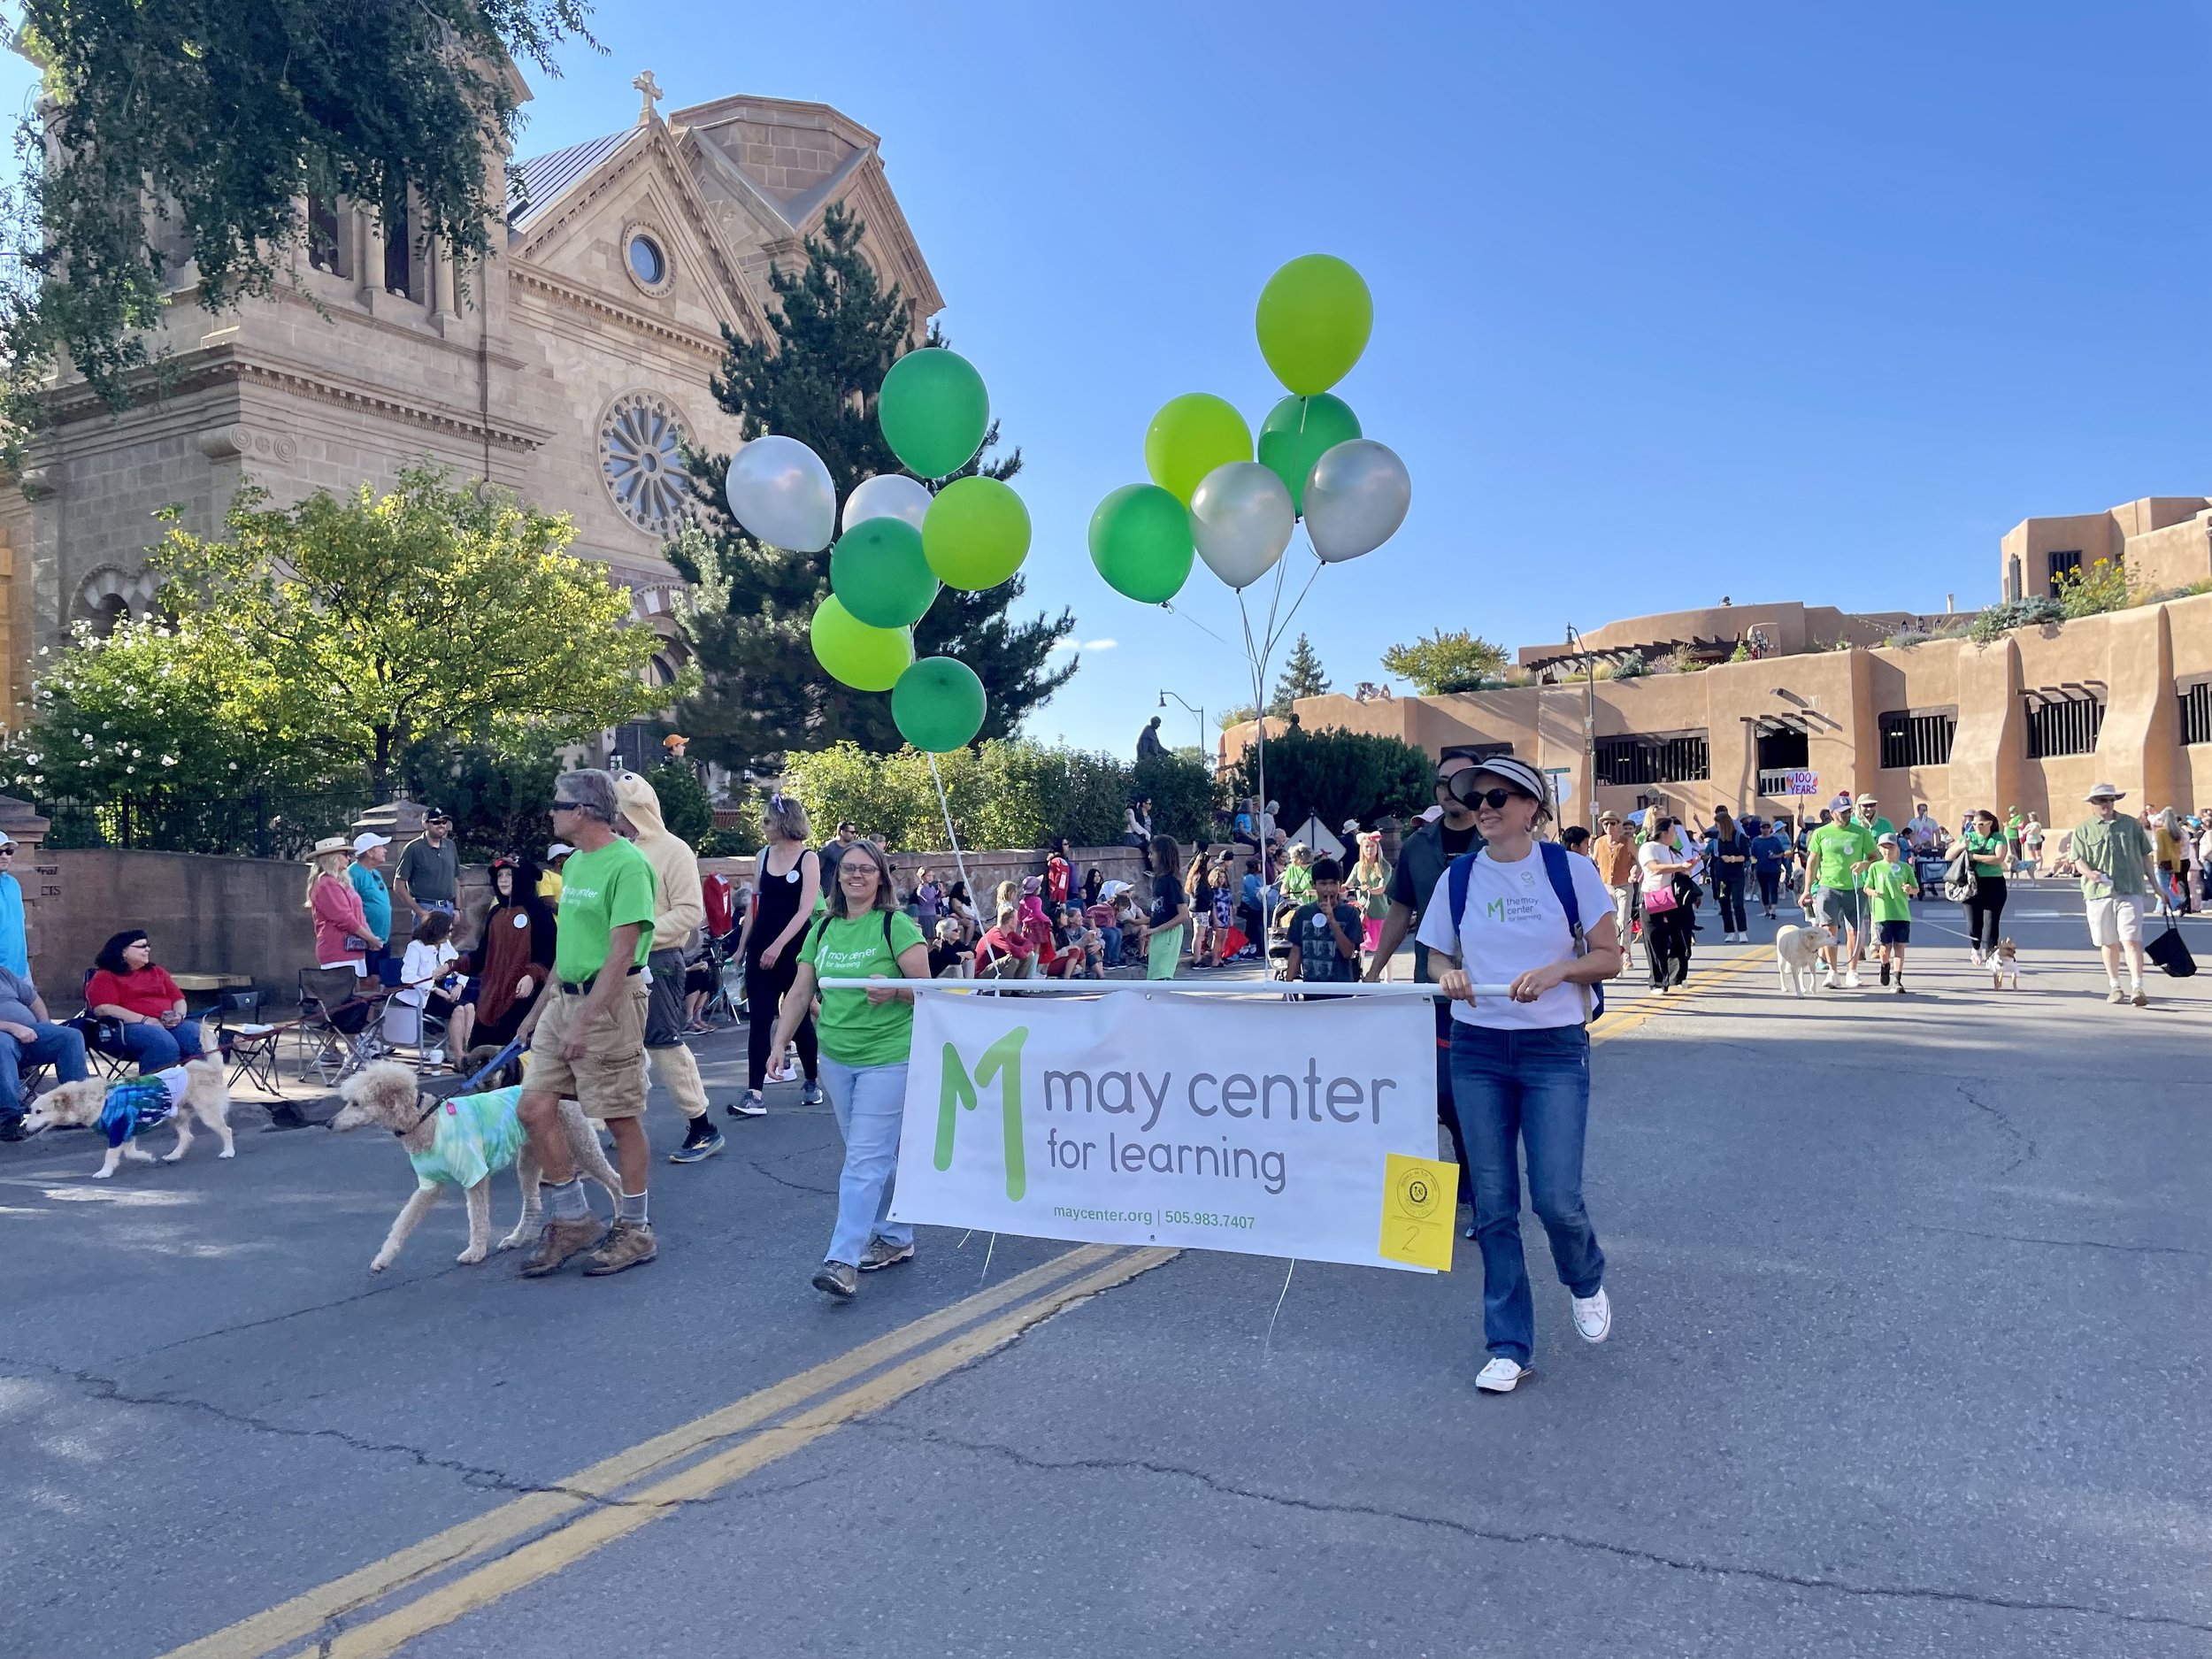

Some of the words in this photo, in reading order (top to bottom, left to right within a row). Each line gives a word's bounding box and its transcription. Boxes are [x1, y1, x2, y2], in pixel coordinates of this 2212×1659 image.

[1795, 772, 1811, 783] 100
[1790, 784, 1817, 795] YEARS
[1506, 897, 1520, 906] the
[1521, 897, 1539, 906] may
[1507, 905, 1533, 915] center
[828, 951, 848, 963] may
[849, 949, 877, 960] cener
[1043, 1070, 1171, 1133] may
[1188, 1057, 1397, 1125] center
[1047, 1127, 1096, 1171] for
[1110, 1132, 1286, 1195] learning
[1054, 1206, 1153, 1225] maycenter.org
[1165, 1210, 1255, 1230] 505.983.7407
[1402, 1225, 1420, 1252] 2
